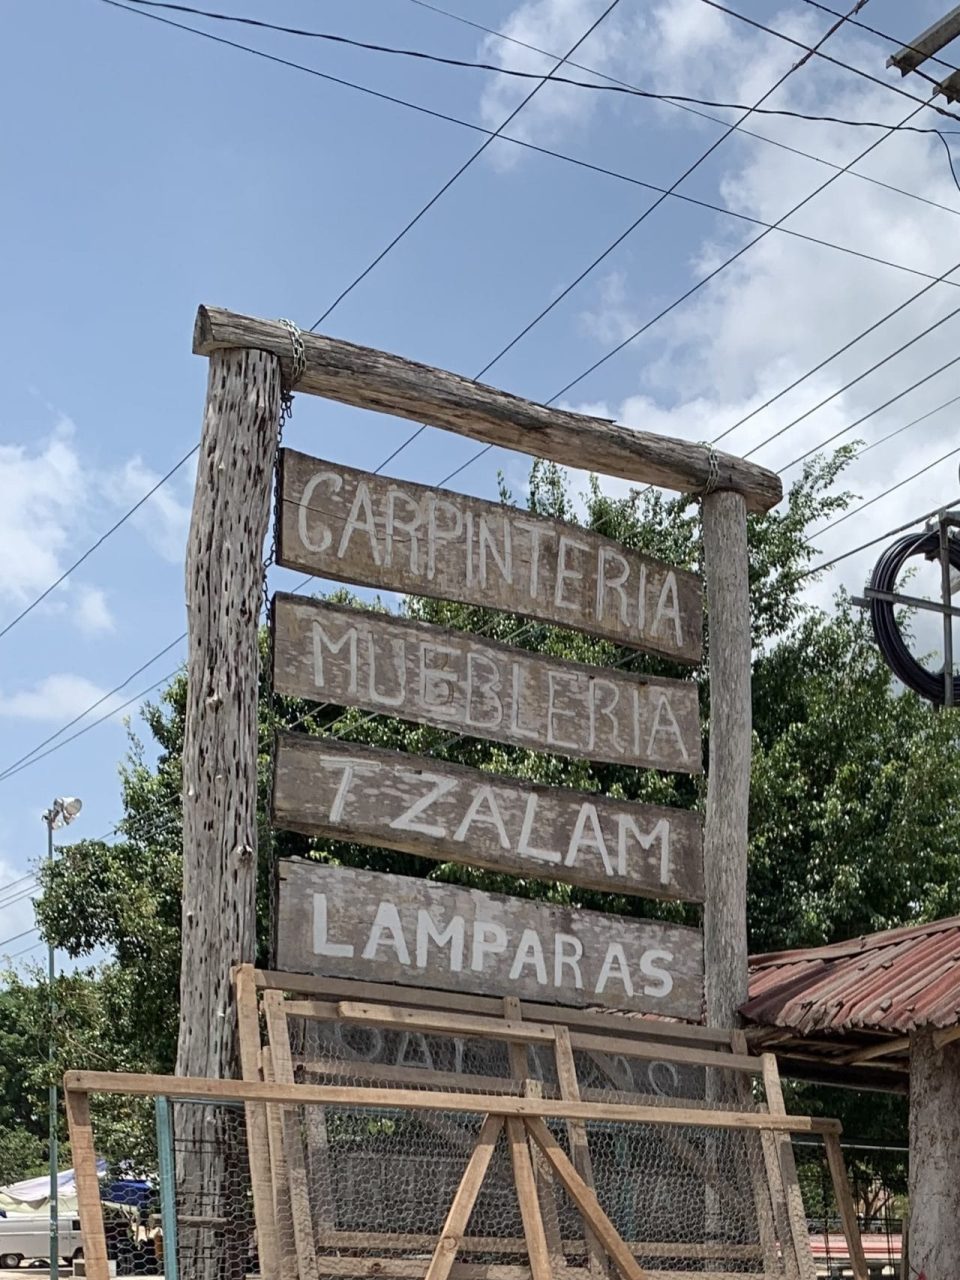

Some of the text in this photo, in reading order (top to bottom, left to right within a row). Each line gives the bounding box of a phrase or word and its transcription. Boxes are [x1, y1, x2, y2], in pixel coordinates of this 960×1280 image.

[298, 470, 684, 647] CARPINTERIA
[312, 620, 690, 761] MUEBLERIA
[319, 755, 671, 884] TZALAM
[312, 893, 675, 998] LAMPARAS
